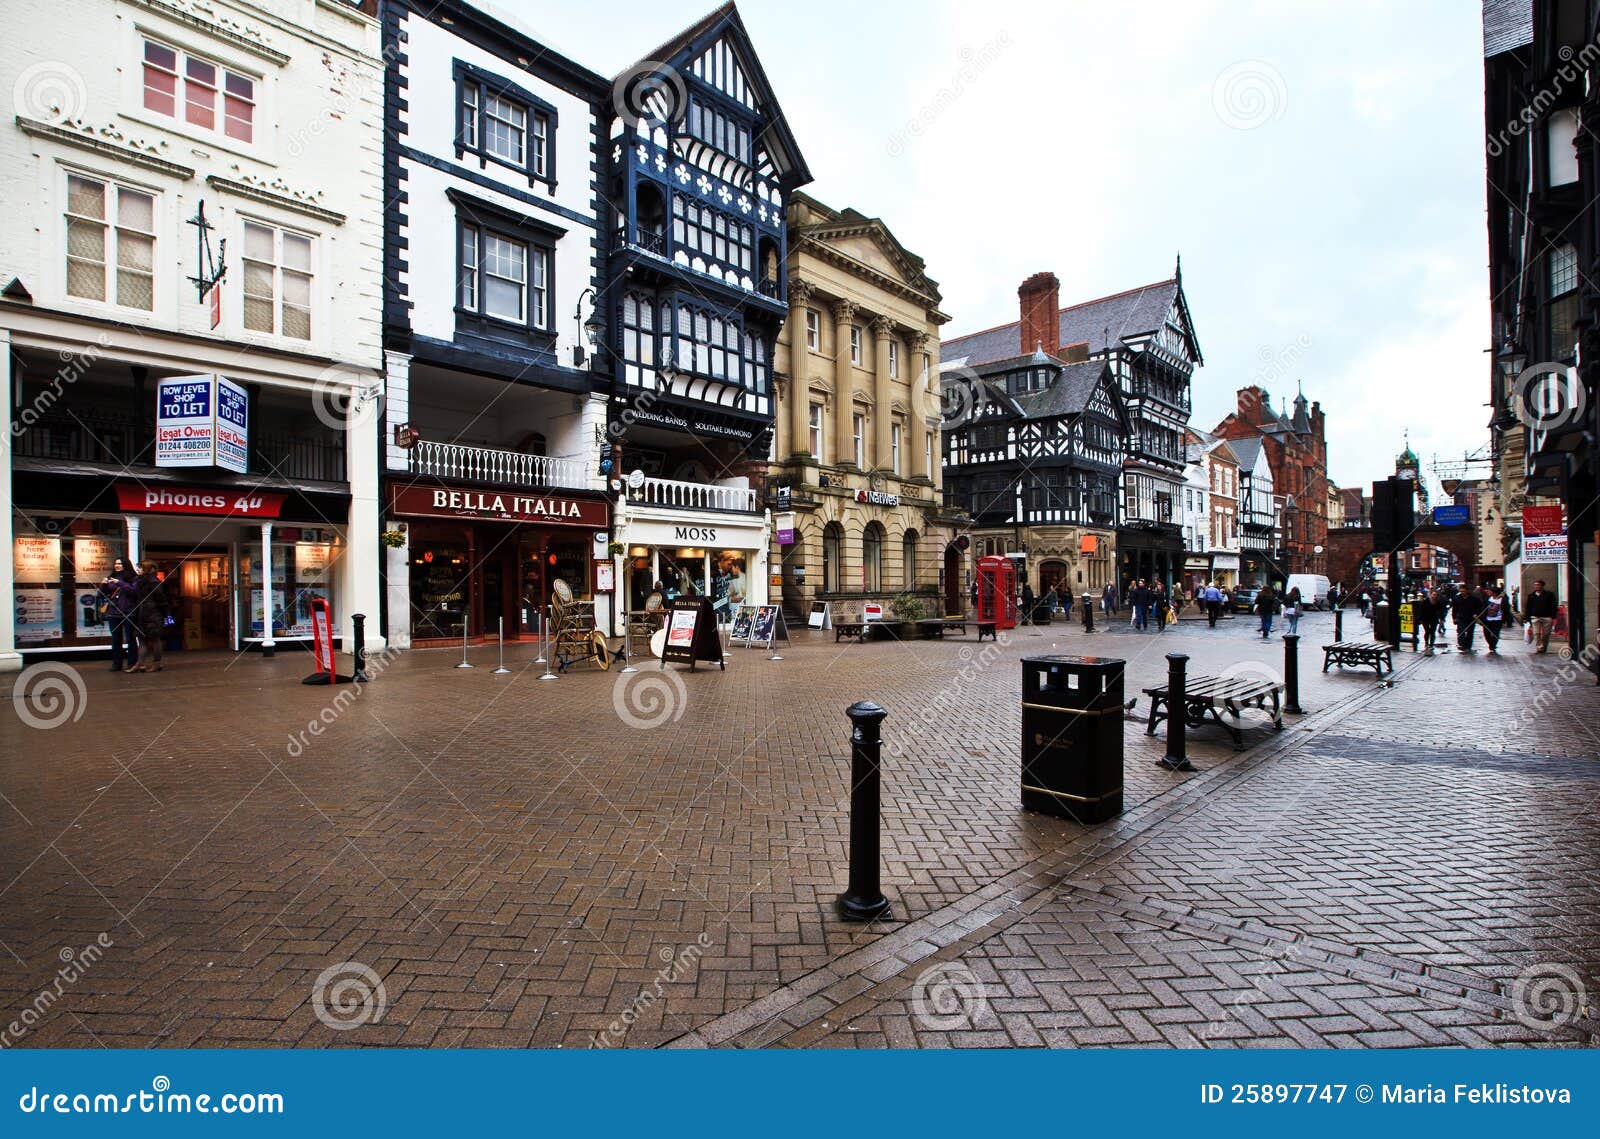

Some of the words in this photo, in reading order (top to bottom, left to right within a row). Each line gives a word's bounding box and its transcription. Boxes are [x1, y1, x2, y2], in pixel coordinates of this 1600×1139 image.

[163, 386, 182, 395] ROW
[183, 384, 207, 394] LEVEL
[173, 393, 196, 403] SHOP
[164, 404, 180, 416] TO
[183, 402, 206, 415] LET
[220, 403, 231, 419] TO
[232, 410, 244, 425] LET
[631, 409, 664, 423] WEDDING
[664, 416, 688, 427] BANDS
[724, 426, 753, 439] DIAMOND
[159, 427, 181, 442] Legat
[184, 426, 211, 437] Owen
[158, 442, 181, 451] 01244
[183, 440, 211, 450] 408200
[145, 488, 226, 508] phones
[433, 490, 507, 512] BELLA
[513, 496, 582, 518] ITALIA
[675, 526, 717, 542] MOSS
[1525, 540, 1546, 550] Legat
